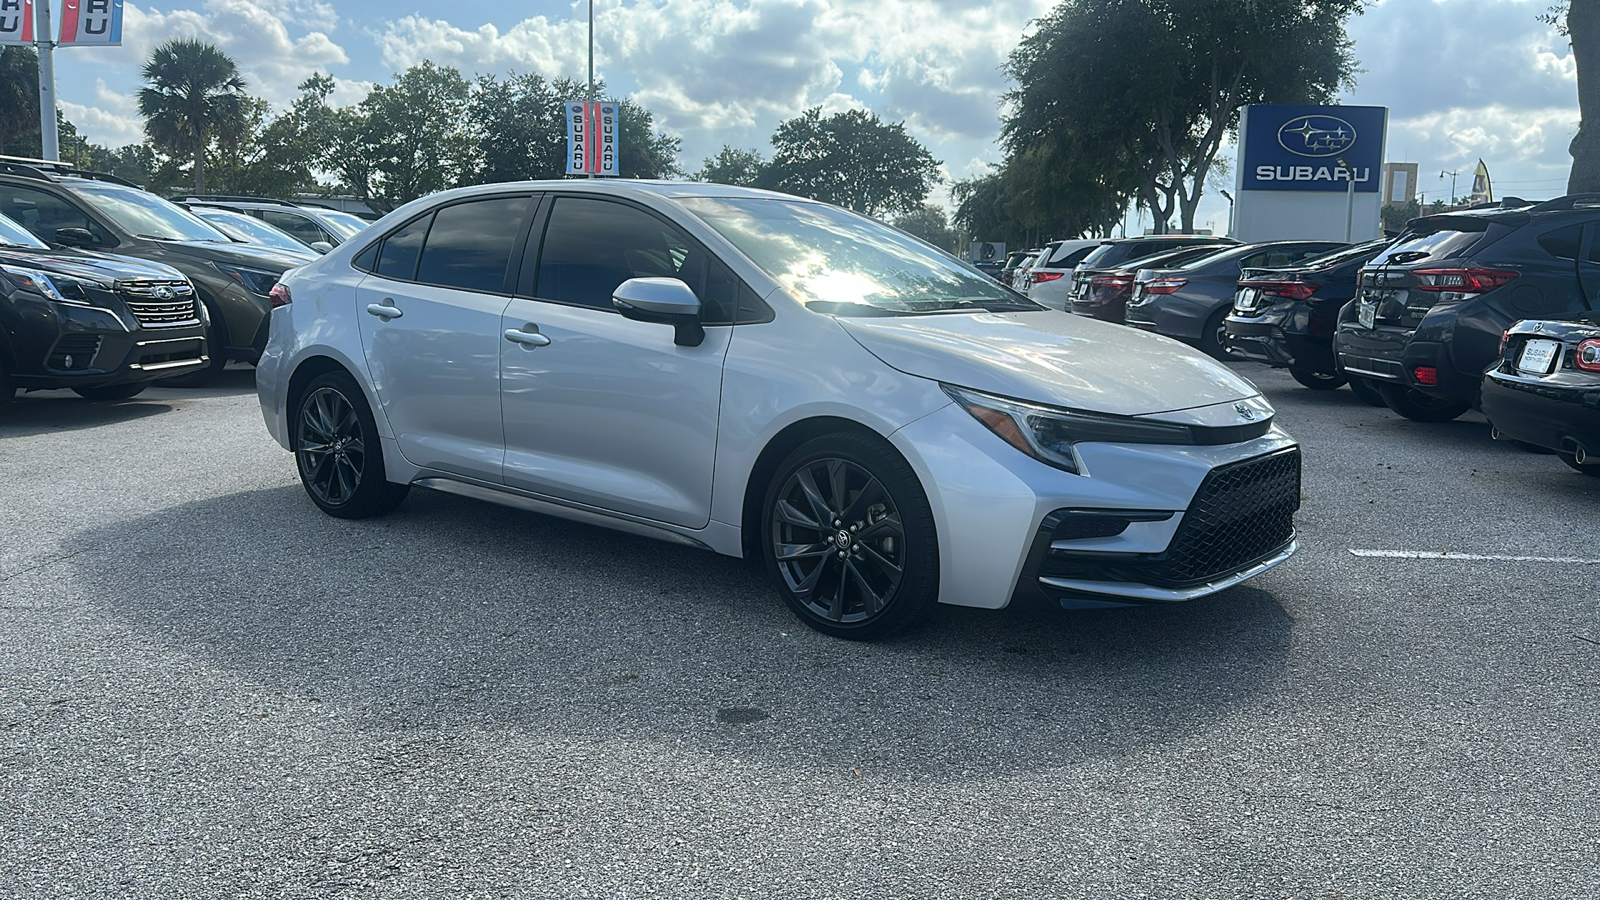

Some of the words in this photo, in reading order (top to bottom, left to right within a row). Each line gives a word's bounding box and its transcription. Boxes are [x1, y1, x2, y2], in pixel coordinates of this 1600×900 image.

[573, 115, 583, 170] SUBARU
[603, 116, 613, 171] SUBARU
[1256, 165, 1370, 182] SUBARU
